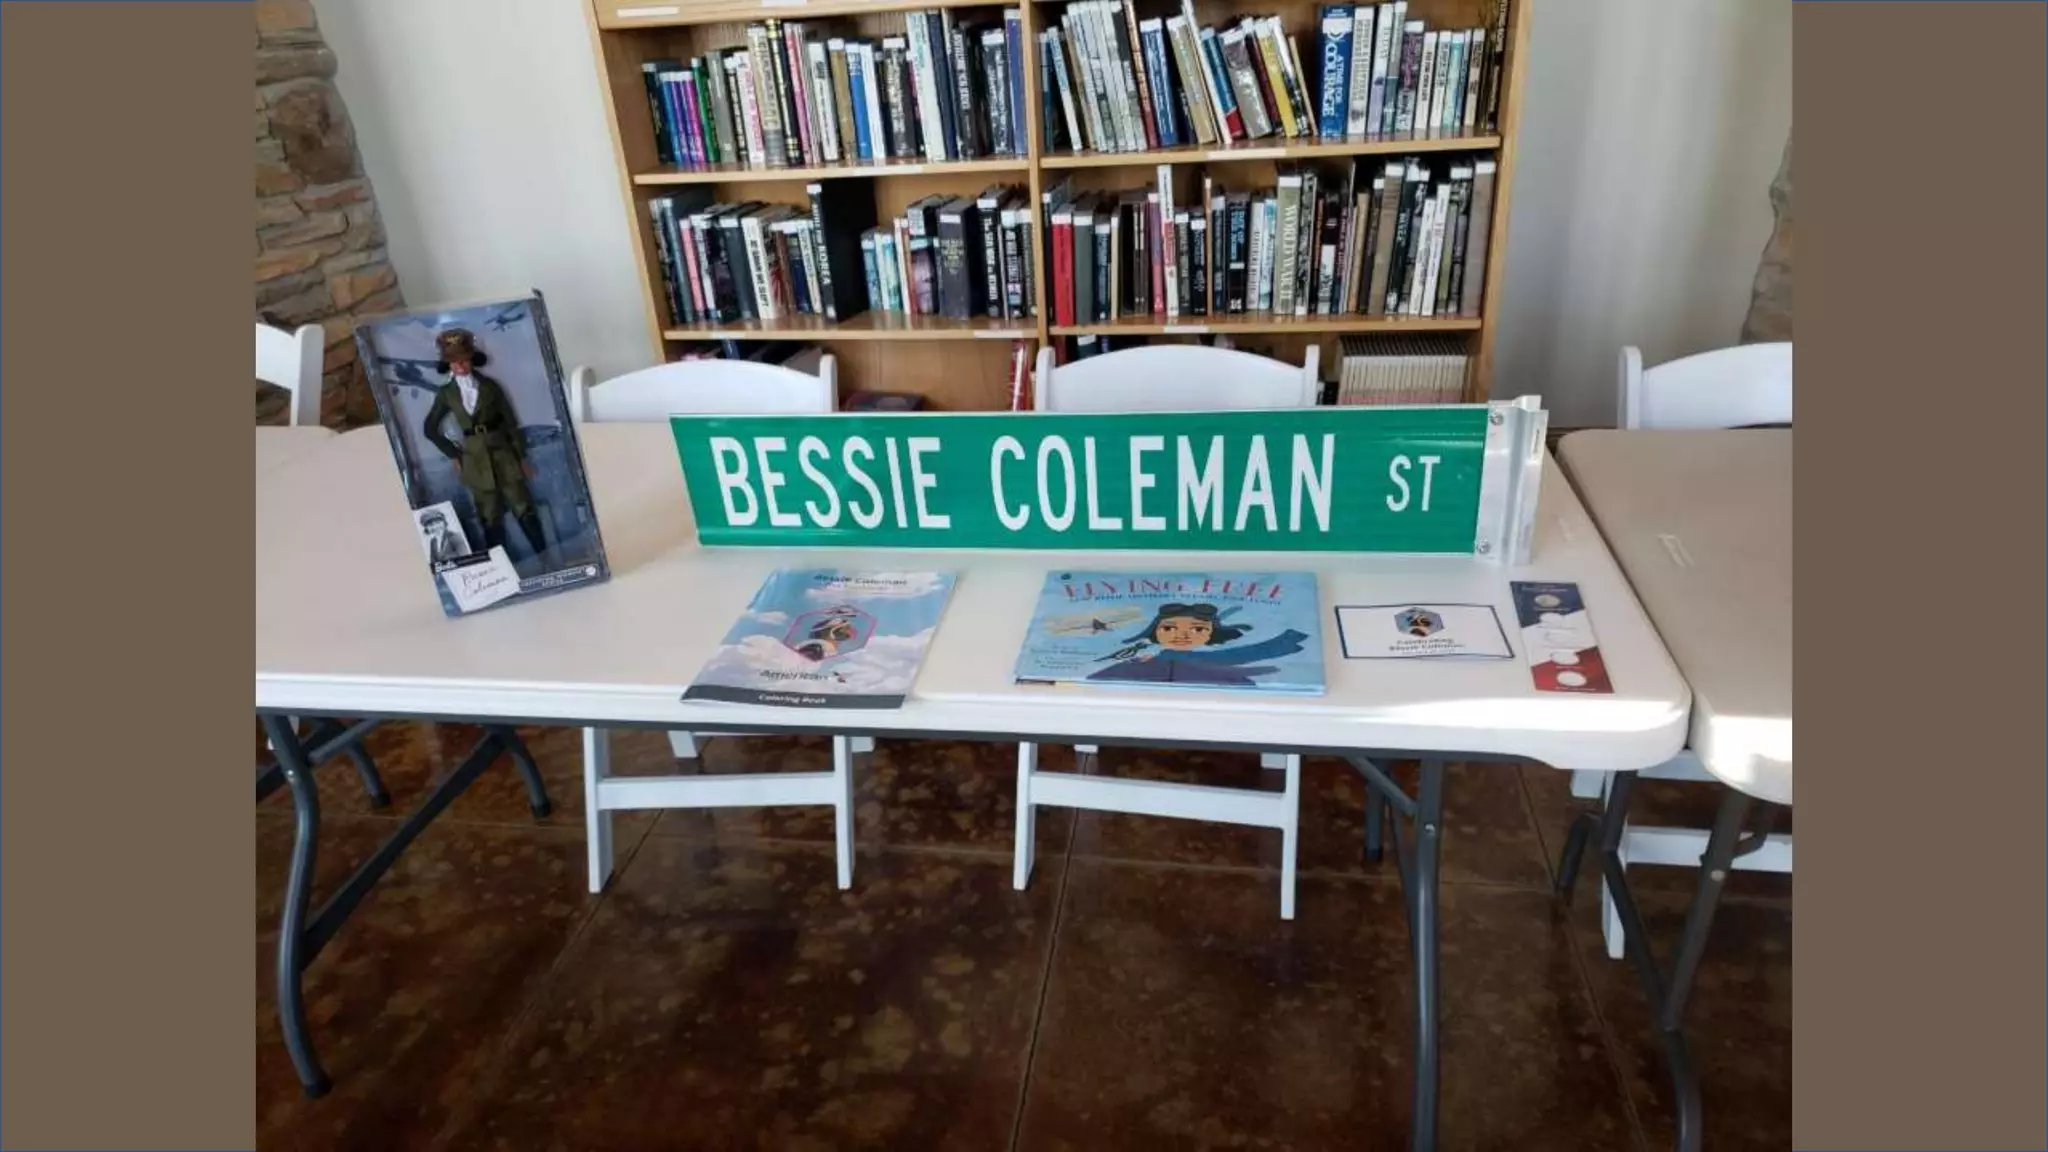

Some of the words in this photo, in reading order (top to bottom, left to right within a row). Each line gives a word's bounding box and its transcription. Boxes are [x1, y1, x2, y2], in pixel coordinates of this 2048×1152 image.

[1322, 42, 1337, 117] COURAGE
[1282, 205, 1298, 254] WORLD
[820, 245, 831, 285] KOREA
[1281, 256, 1295, 290] WAR
[1280, 290, 1293, 300] II
[710, 435, 952, 530] BESSIE
[990, 433, 1335, 533] COLEMAN
[1386, 455, 1442, 513] ST
[759, 668, 830, 682] American
[758, 693, 801, 705] Coloring
